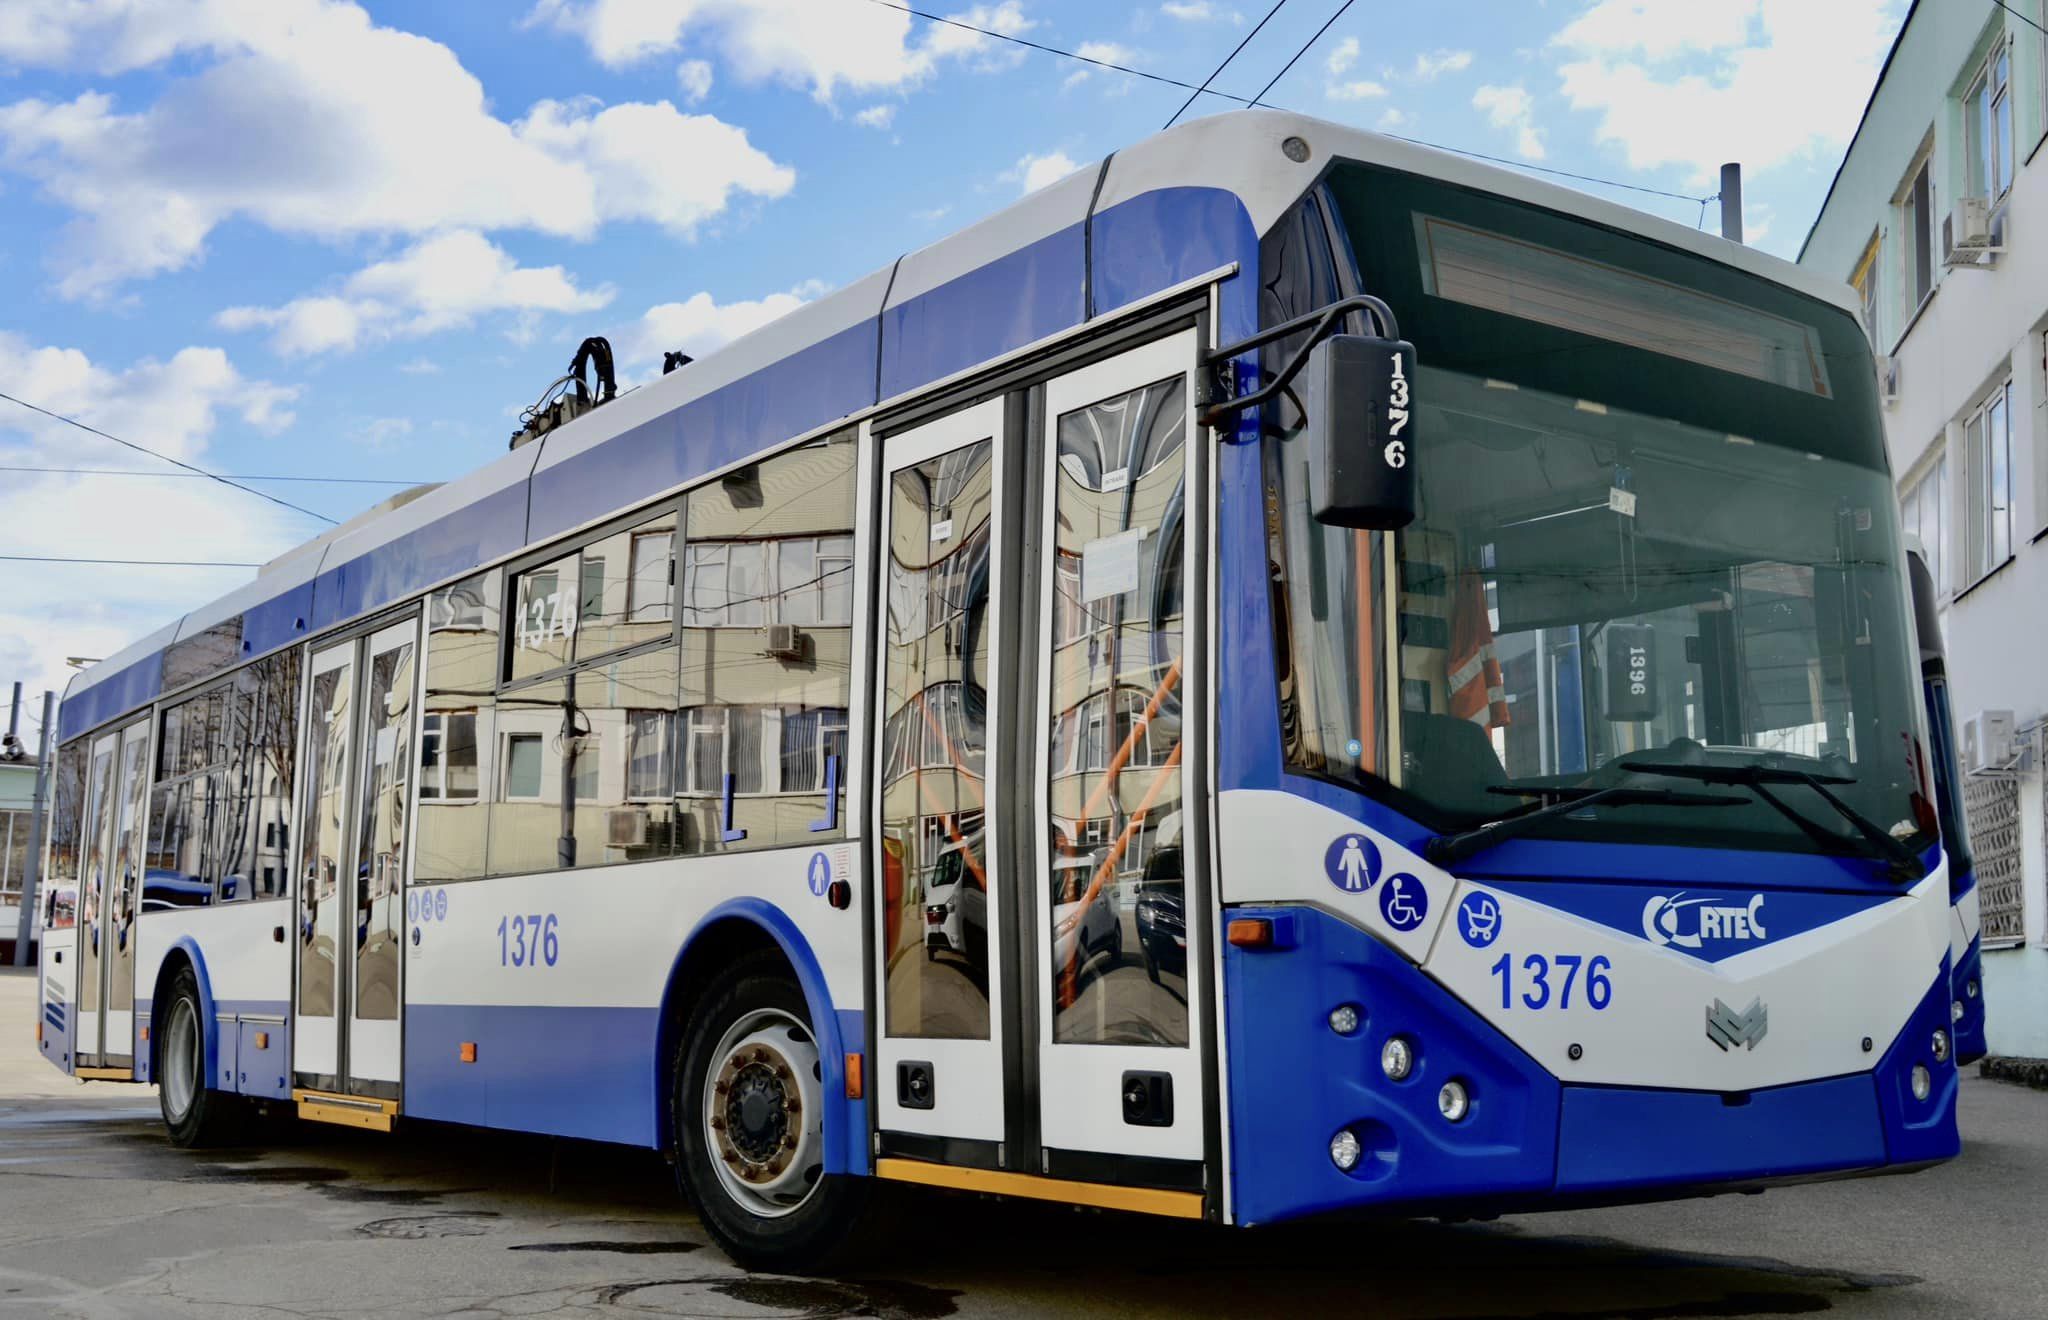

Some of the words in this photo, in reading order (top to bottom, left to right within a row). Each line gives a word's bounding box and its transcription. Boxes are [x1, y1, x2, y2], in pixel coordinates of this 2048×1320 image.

[1384, 352, 1409, 469] 1376
[516, 586, 577, 653] 1376
[1630, 647, 1646, 695] 1396
[497, 912, 558, 968] 1376
[1491, 953, 1612, 1010] 1376
